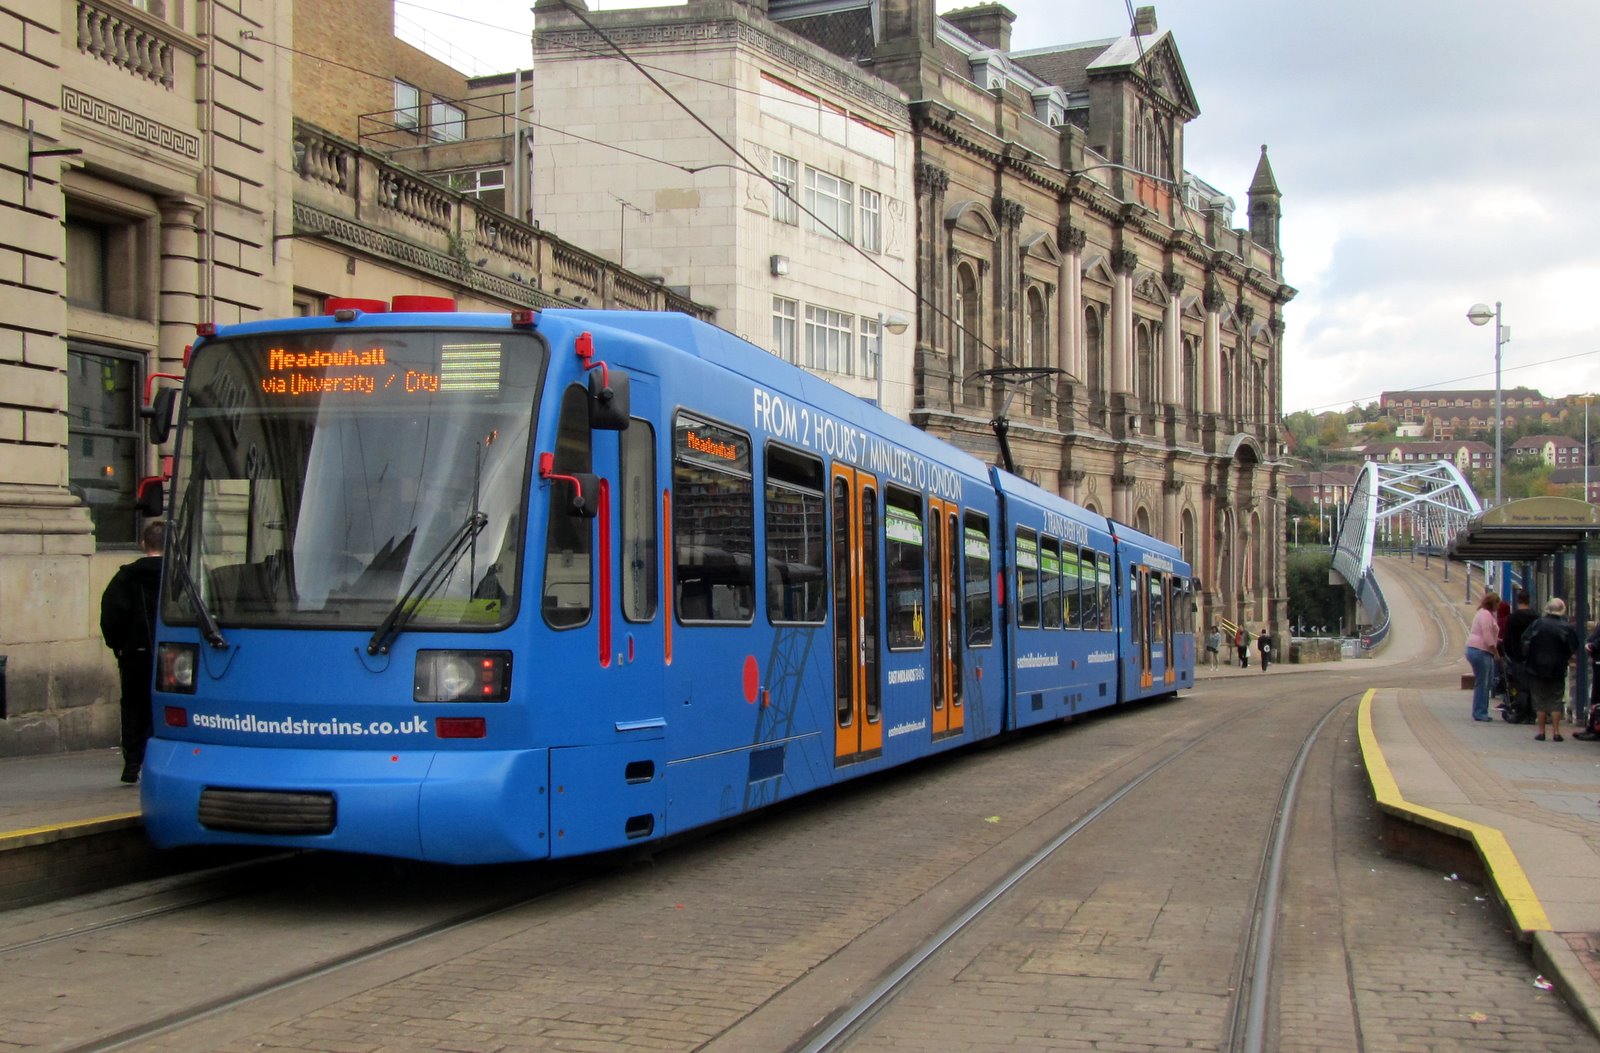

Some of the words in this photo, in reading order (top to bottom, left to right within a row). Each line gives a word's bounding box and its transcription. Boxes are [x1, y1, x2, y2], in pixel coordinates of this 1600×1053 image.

[270, 348, 386, 370] Meadowhall
[262, 376, 286, 393] via
[290, 373, 375, 395] University
[405, 371, 439, 393] City
[687, 430, 737, 461] Meadowhall
[753, 387, 798, 443] FROM
[801, 408, 810, 447] 2
[814, 413, 857, 464] HOURS
[859, 433, 866, 466] 7
[870, 436, 912, 485] MINUTES
[913, 456, 926, 490] TO
[927, 461, 962, 501] LONDON
[192, 711, 429, 735] eastmidlandstrains.co.uk
